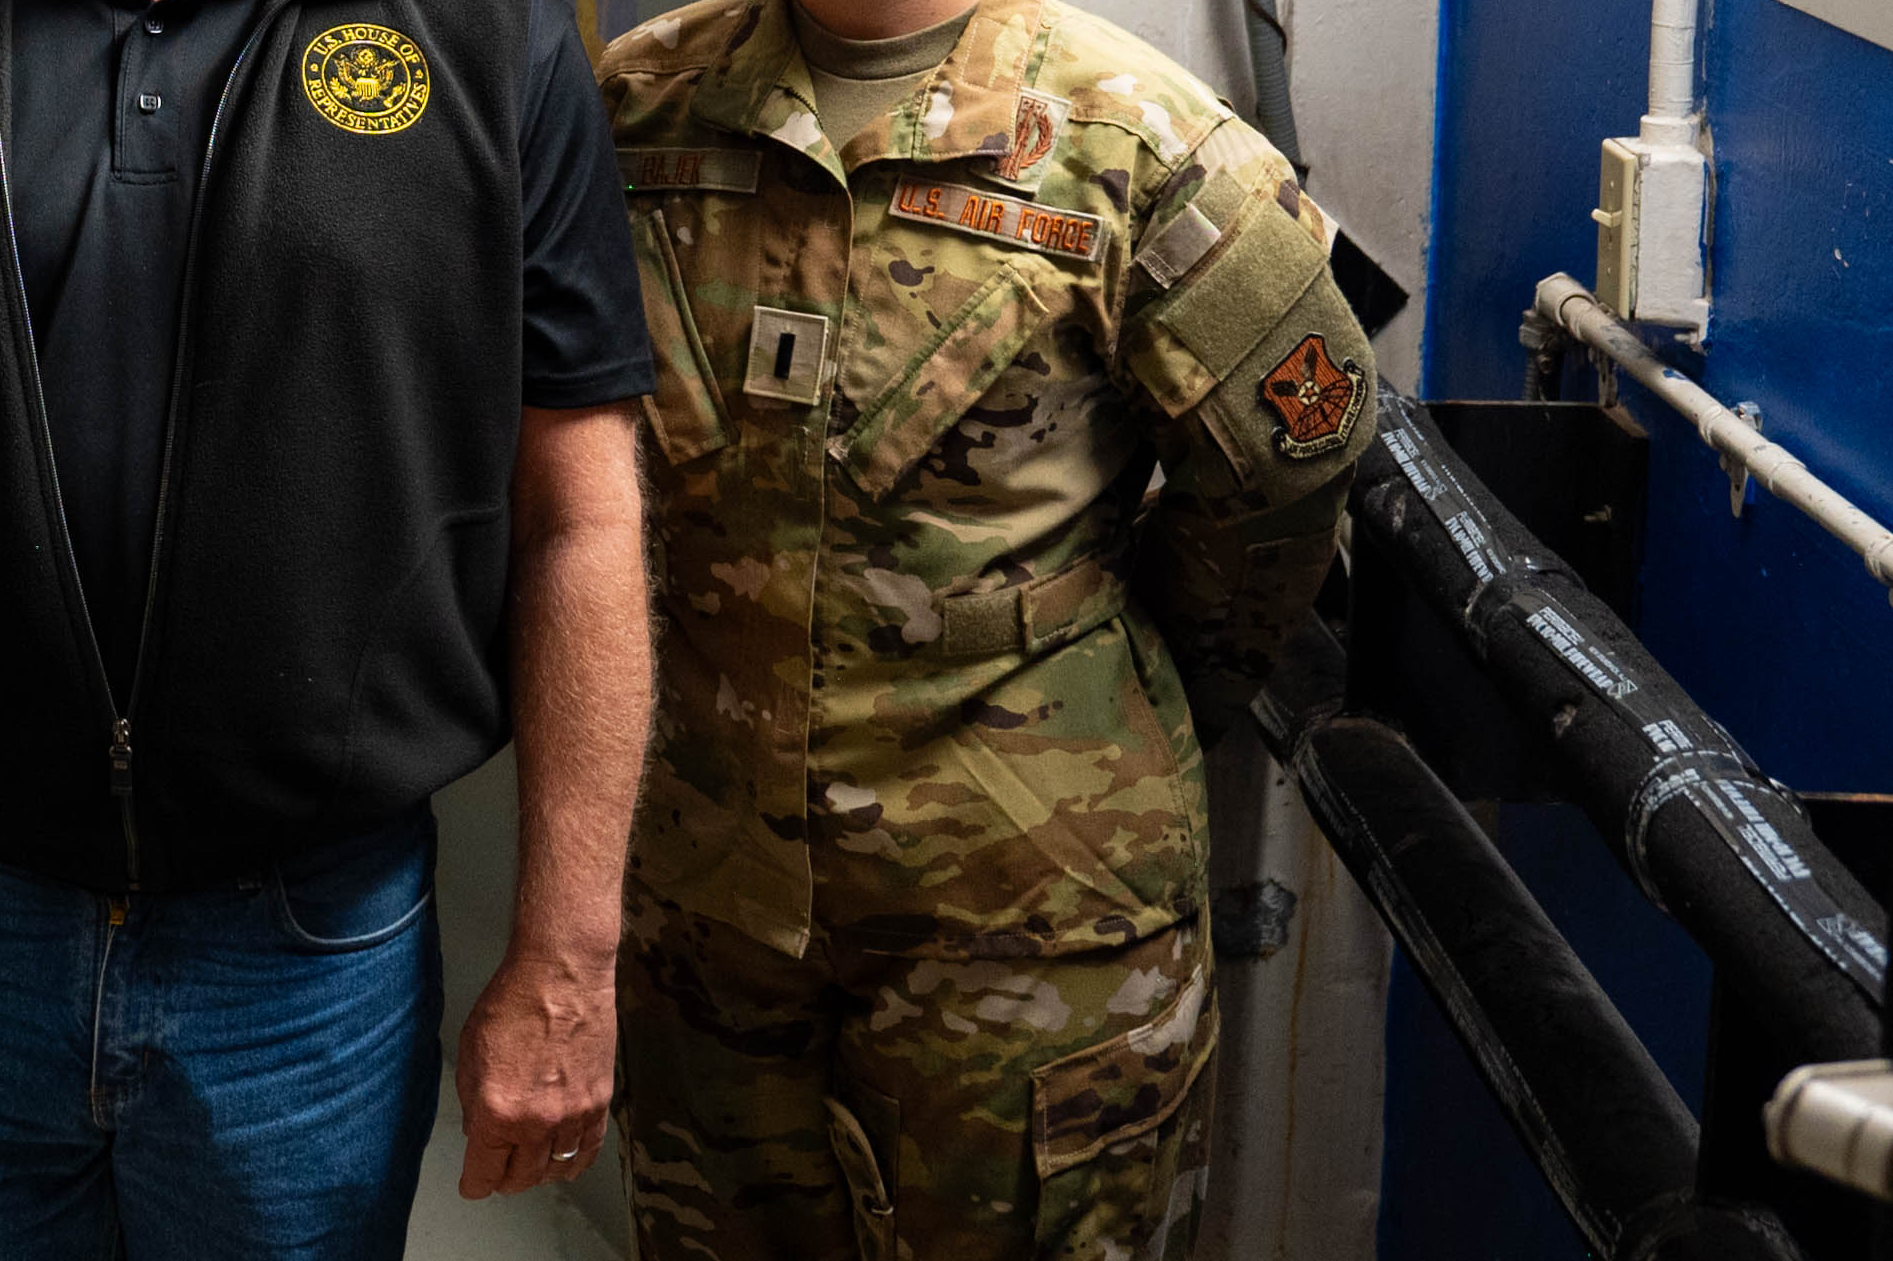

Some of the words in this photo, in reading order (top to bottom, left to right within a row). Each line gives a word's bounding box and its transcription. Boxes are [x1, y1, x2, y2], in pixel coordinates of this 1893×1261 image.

[313, 34, 342, 56] U.S.
[343, 28, 400, 46] HOUSE
[399, 44, 421, 65] OF
[308, 79, 427, 130] REPRESENTATIVES
[899, 185, 945, 219] U.S.
[959, 195, 1006, 234] AIR
[1015, 207, 1094, 253] FORCE
